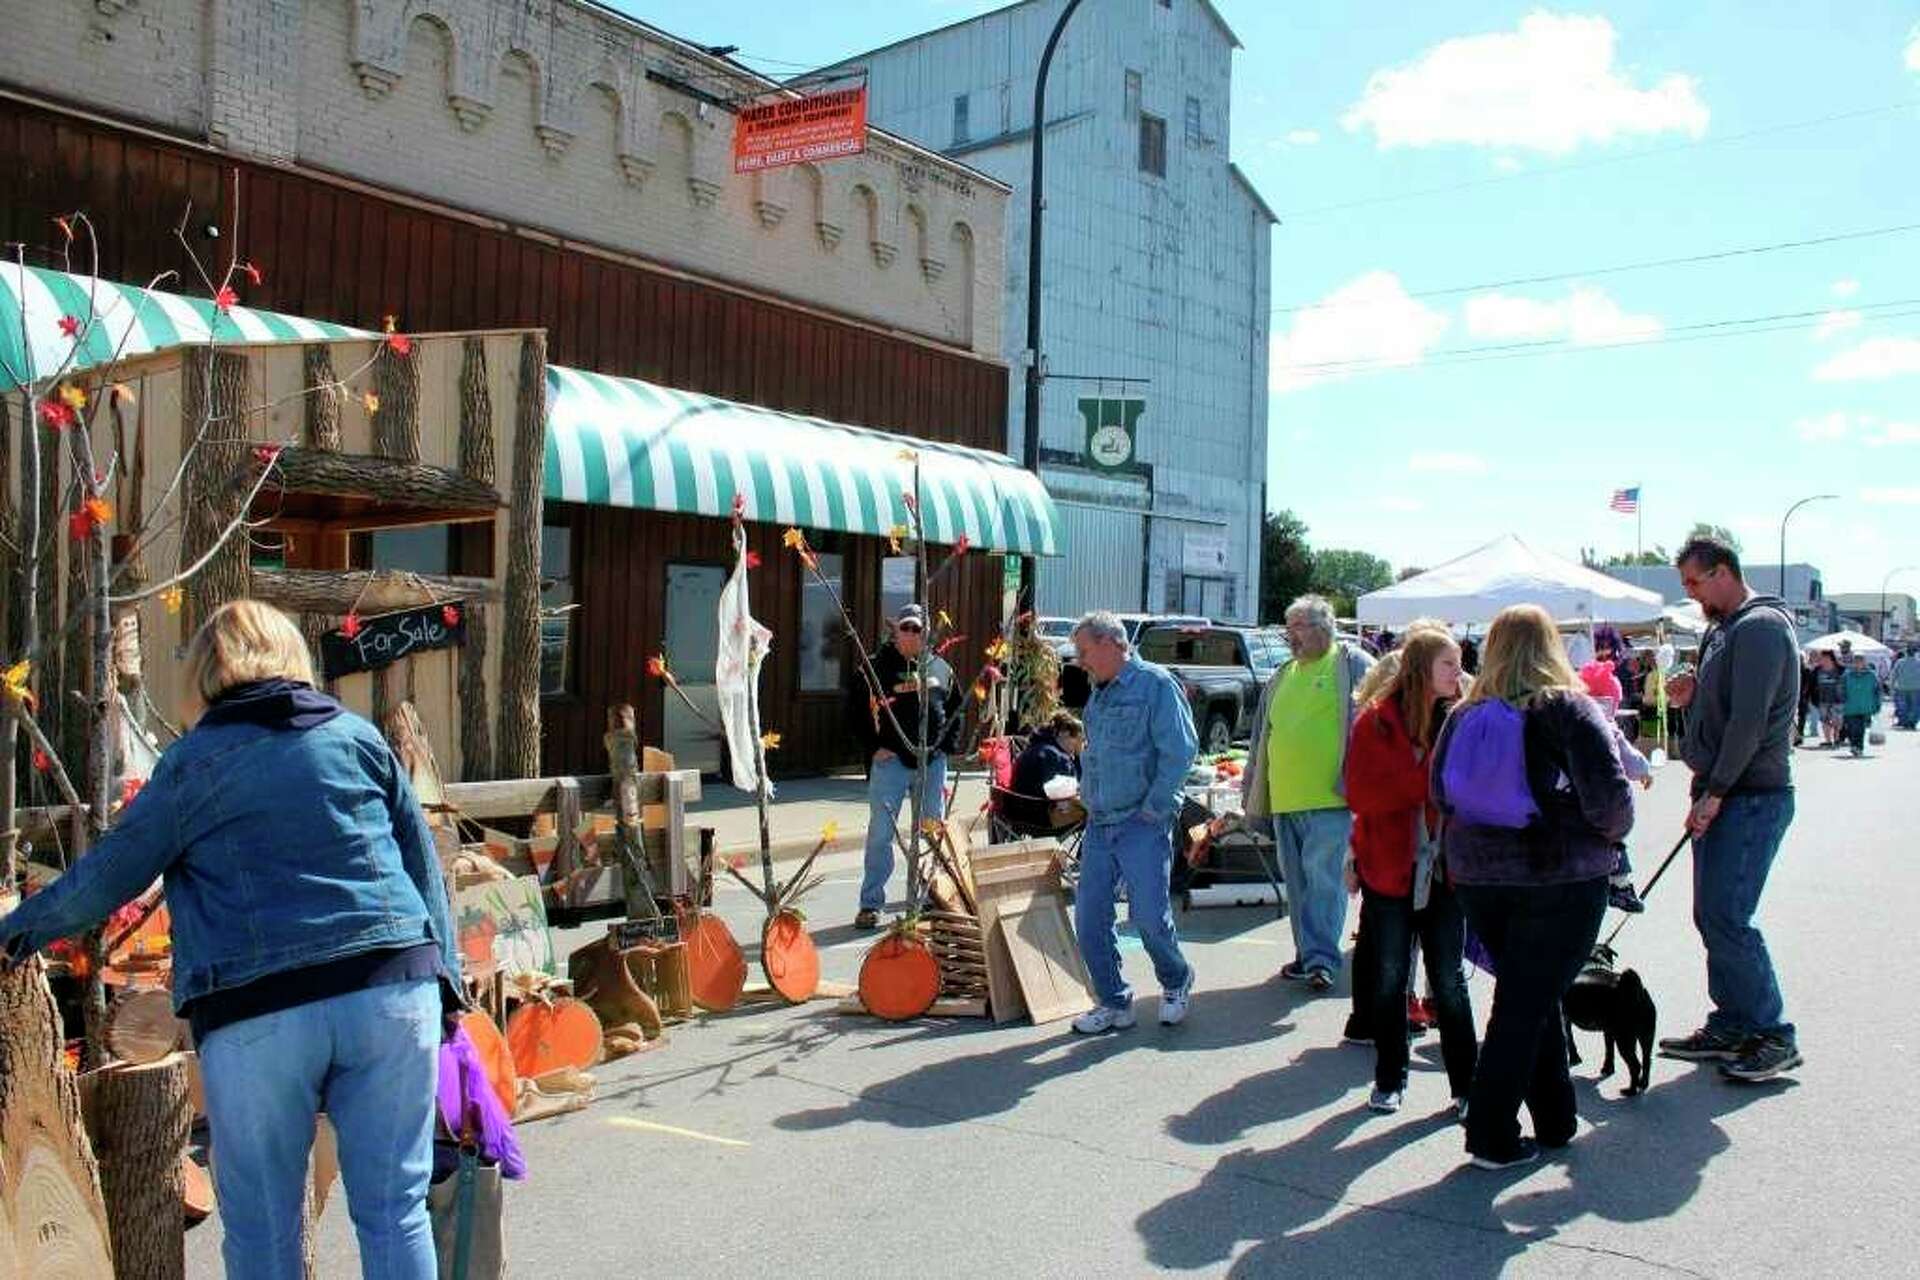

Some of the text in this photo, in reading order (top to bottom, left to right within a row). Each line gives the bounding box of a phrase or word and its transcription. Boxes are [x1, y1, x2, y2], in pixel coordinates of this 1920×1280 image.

[740, 104, 776, 122] WATER
[350, 615, 446, 663] For Sale
